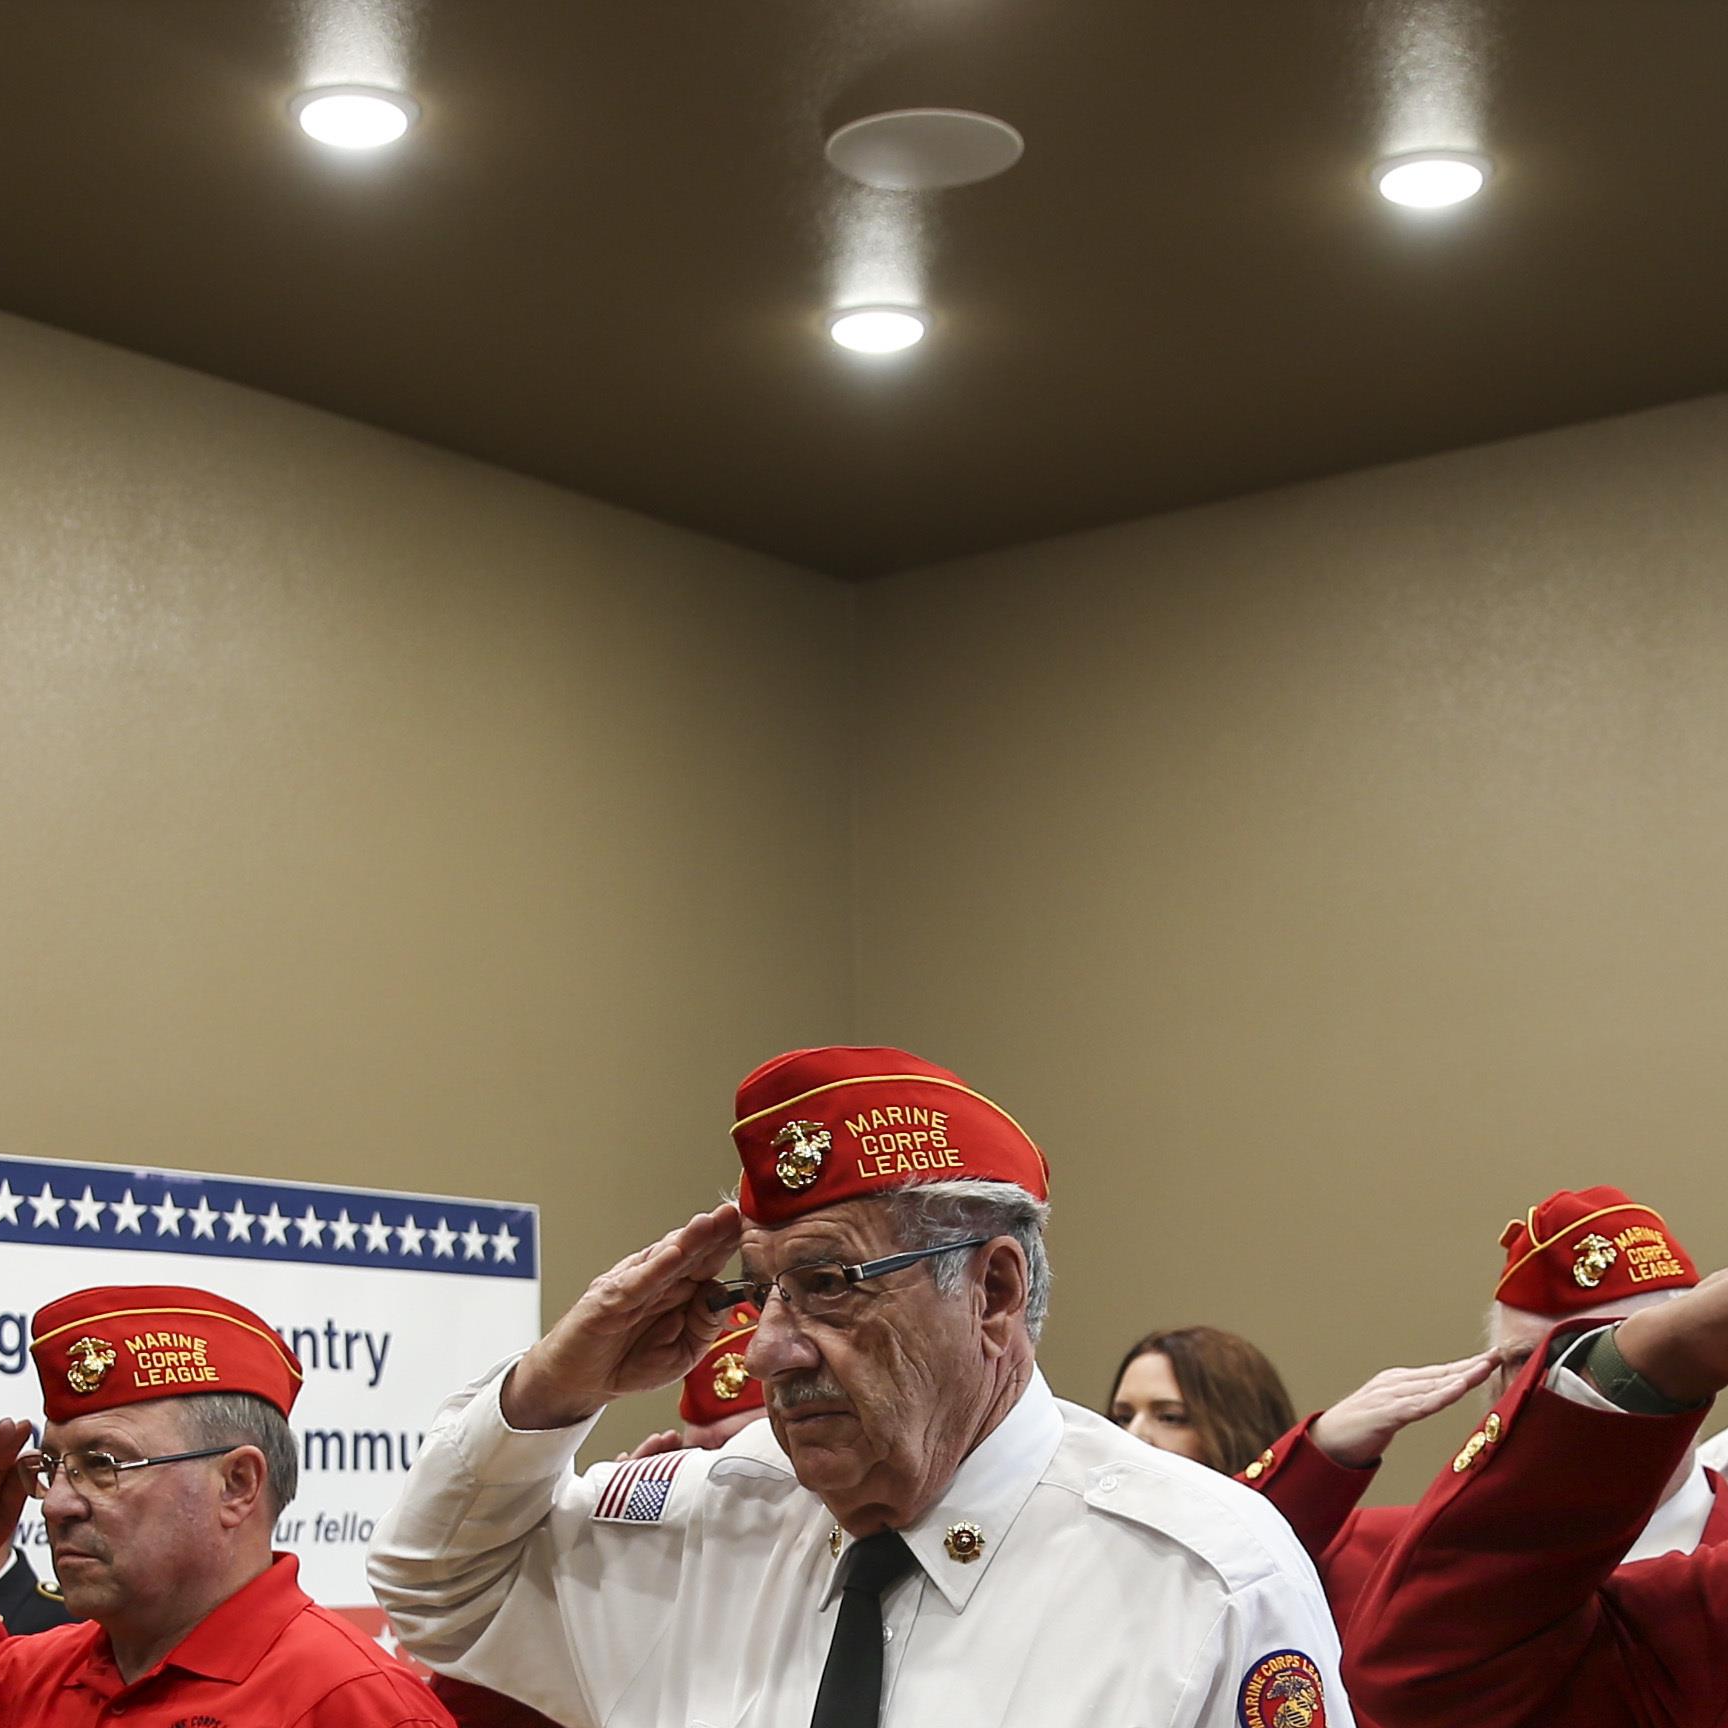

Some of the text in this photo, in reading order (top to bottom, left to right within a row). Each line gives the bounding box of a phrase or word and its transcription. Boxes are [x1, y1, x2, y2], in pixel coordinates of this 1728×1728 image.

[844, 1106, 950, 1138] MARINE
[860, 1130, 948, 1156] CORPS
[857, 1149, 964, 1178] LEAGUE
[1614, 1227, 1667, 1252] MARINE
[1626, 1245, 1672, 1265] CORPS
[1628, 1259, 1685, 1282] LEAGUE
[125, 1333, 208, 1354] MARINE
[138, 1350, 207, 1369] CORPS
[134, 1366, 220, 1387] LEAGUE
[1260, 1655, 1301, 1677] CORPS
[190, 1715, 221, 1728] CORPS
